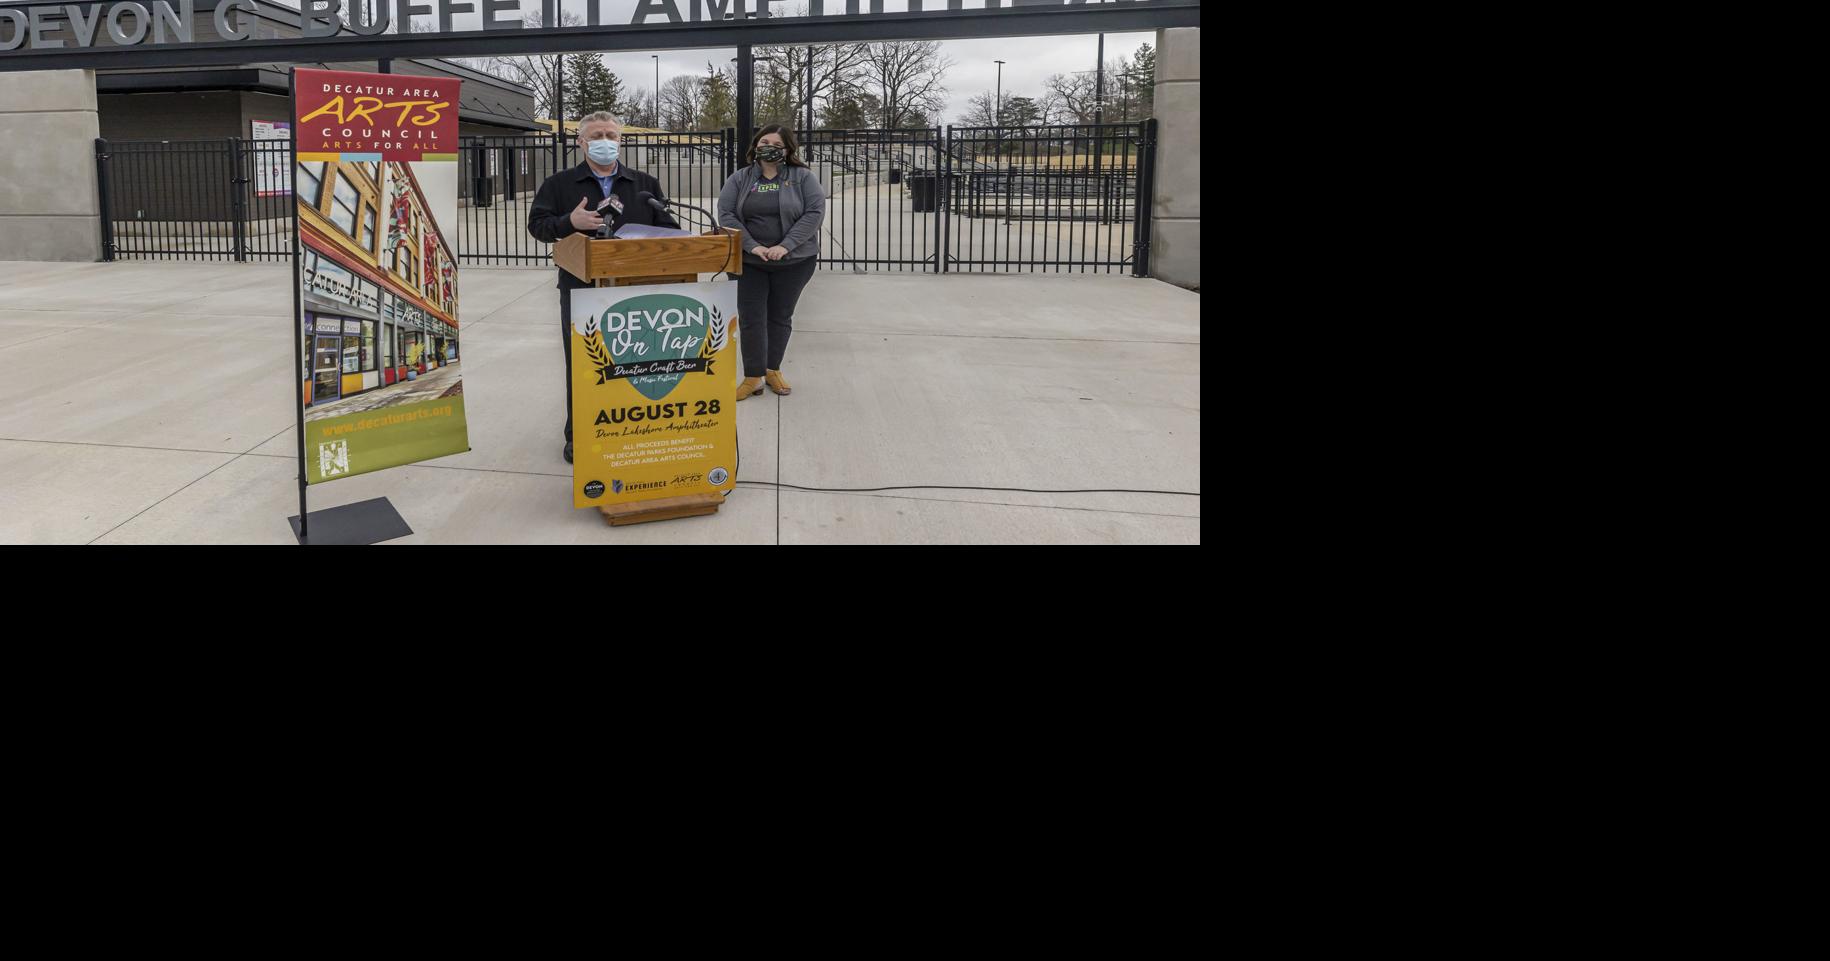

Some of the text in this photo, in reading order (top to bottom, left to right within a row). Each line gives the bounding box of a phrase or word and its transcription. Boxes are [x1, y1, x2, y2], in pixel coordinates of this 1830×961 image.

[0, 0, 194, 50] DEVON
[323, 84, 440, 98] DECATUR AREA
[300, 95, 450, 127] ARTS
[322, 128, 438, 139] COUNCIL
[322, 141, 438, 150] ARTS FOR ALL
[607, 307, 704, 332] DEVON
[611, 324, 703, 359] On Tap
[614, 360, 697, 376] Decatur Craft Beer
[594, 399, 721, 426] AUGUST 28
[322, 405, 452, 437] www.decaturarts.org
[595, 418, 719, 439] Devon Lakeshore Amphitheater
[636, 440, 670, 449] PROCEEDS
[670, 437, 695, 446] BENEFIT
[616, 451, 646, 459] DECATUR
[667, 445, 708, 453] FOUNDATION
[610, 459, 640, 468] DECATUR
[625, 481, 667, 491] EXPERIENCE
